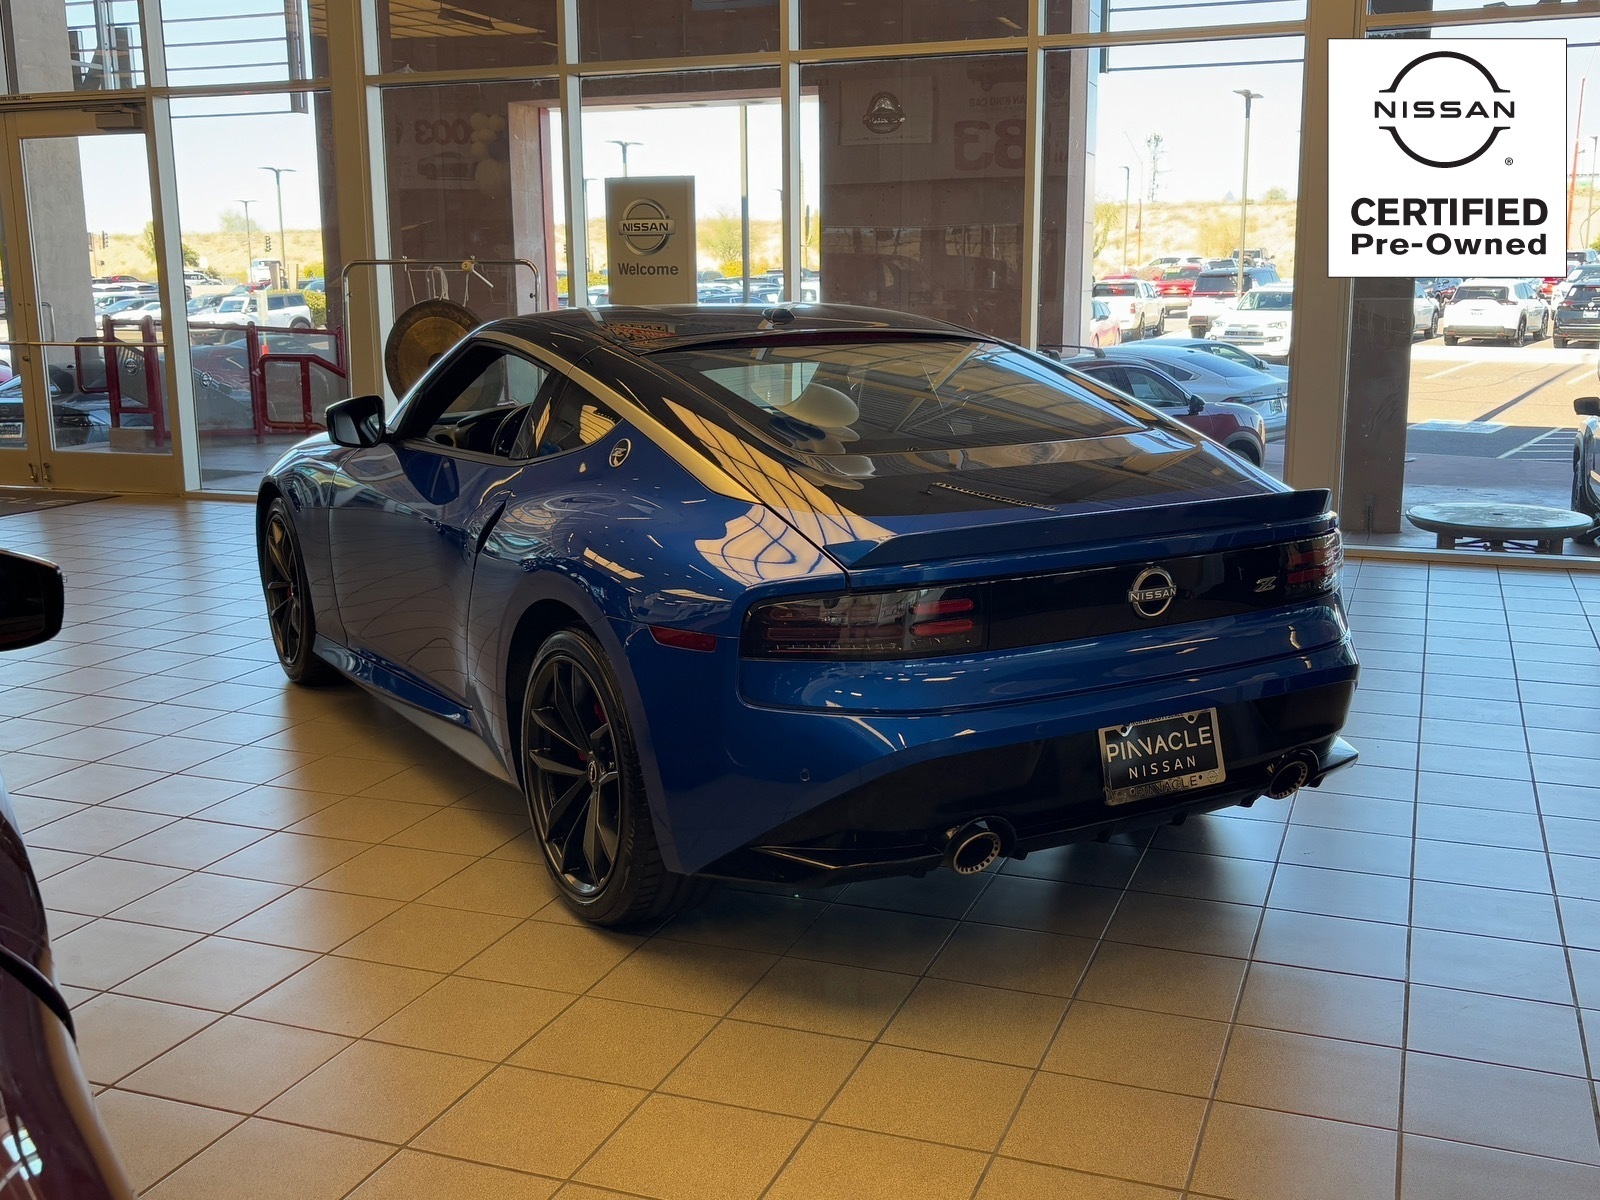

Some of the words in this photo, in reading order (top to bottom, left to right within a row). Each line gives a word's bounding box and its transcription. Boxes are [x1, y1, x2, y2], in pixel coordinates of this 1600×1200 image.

[622, 222, 669, 231] NISSAN
[618, 263, 679, 276] Welcome
[1130, 587, 1177, 601] NISSAN
[1106, 726, 1213, 763] PINNACLE
[1129, 755, 1196, 779] NISSAN
